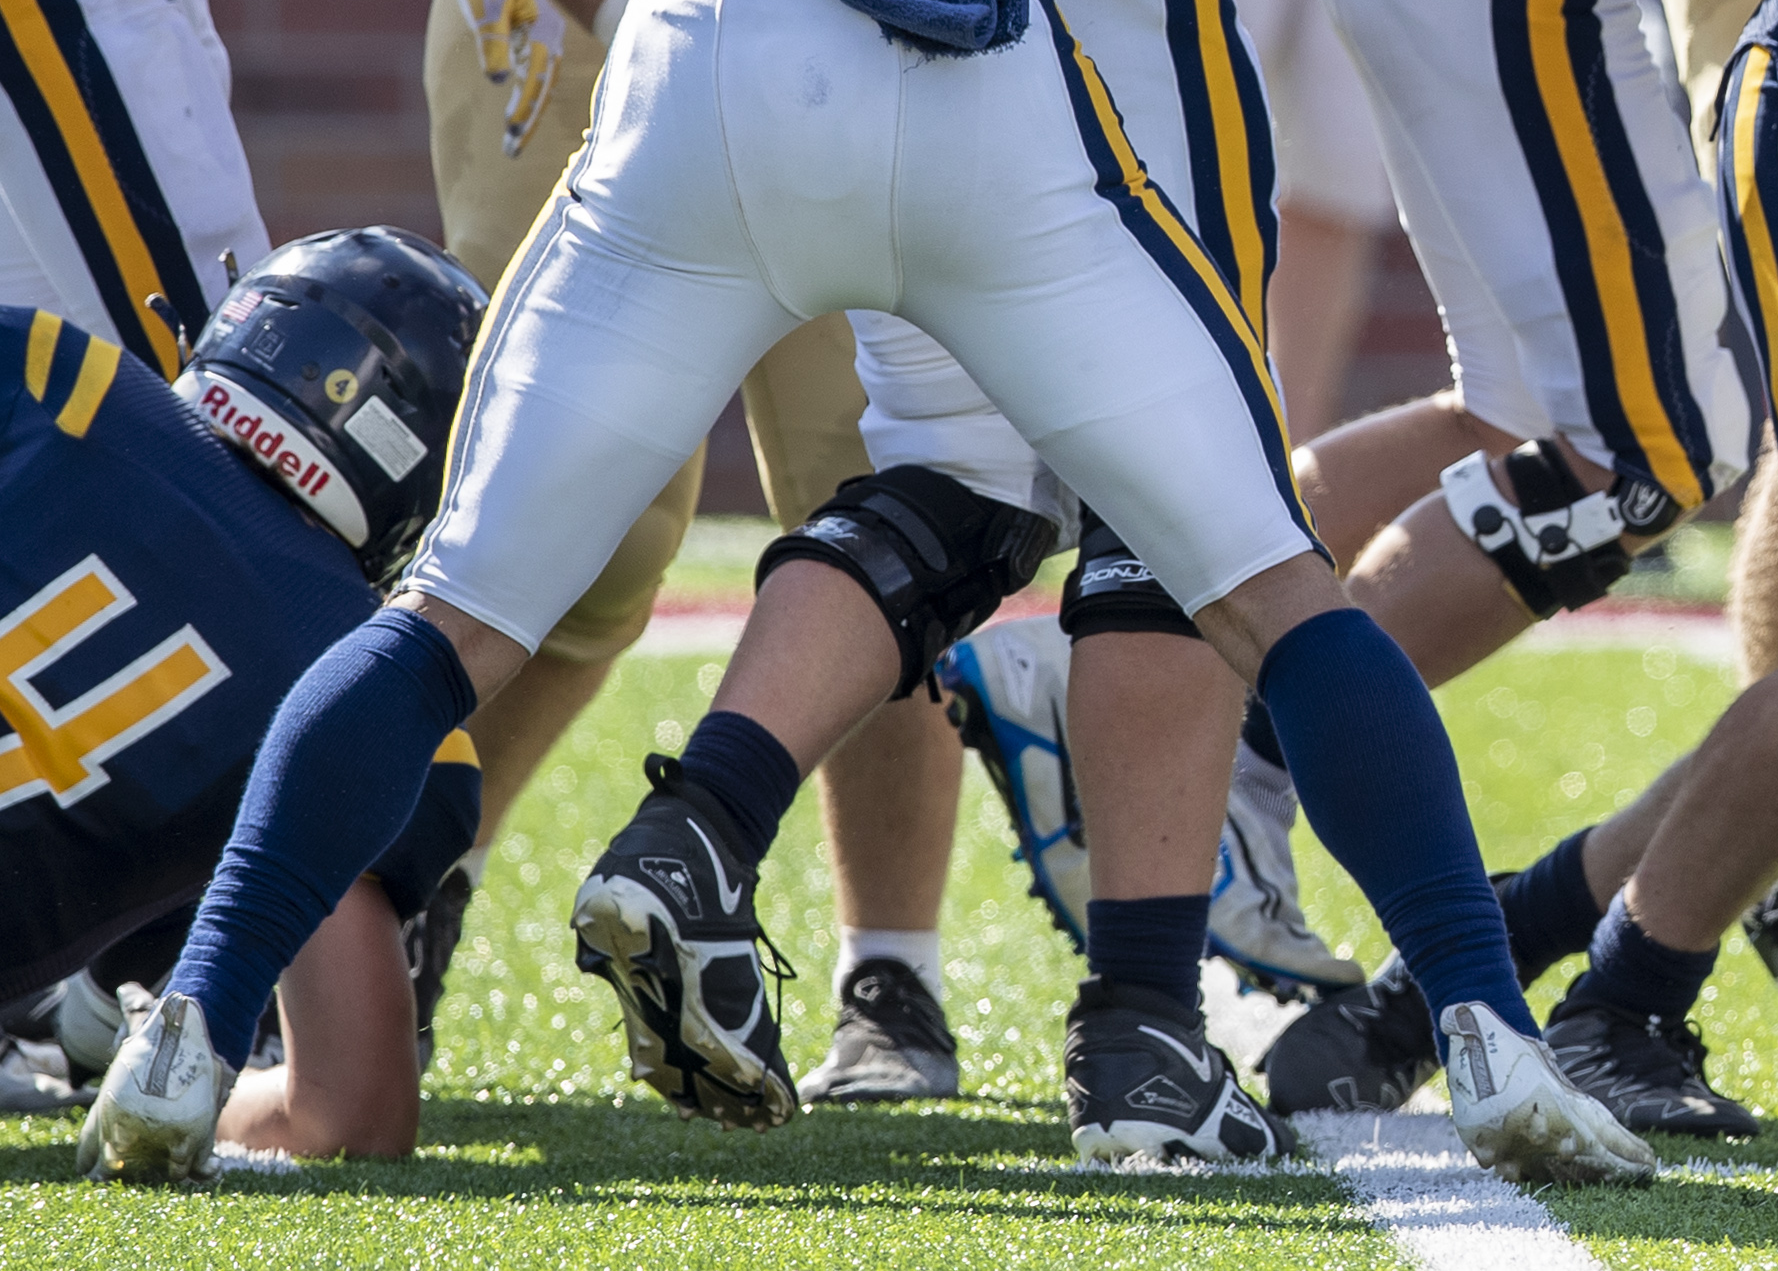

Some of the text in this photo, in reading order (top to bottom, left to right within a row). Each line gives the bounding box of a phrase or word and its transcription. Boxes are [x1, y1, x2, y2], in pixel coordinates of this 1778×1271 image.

[200, 384, 330, 497] Riddell
[335, 378, 350, 397] 4
[0, 554, 232, 809] 4
